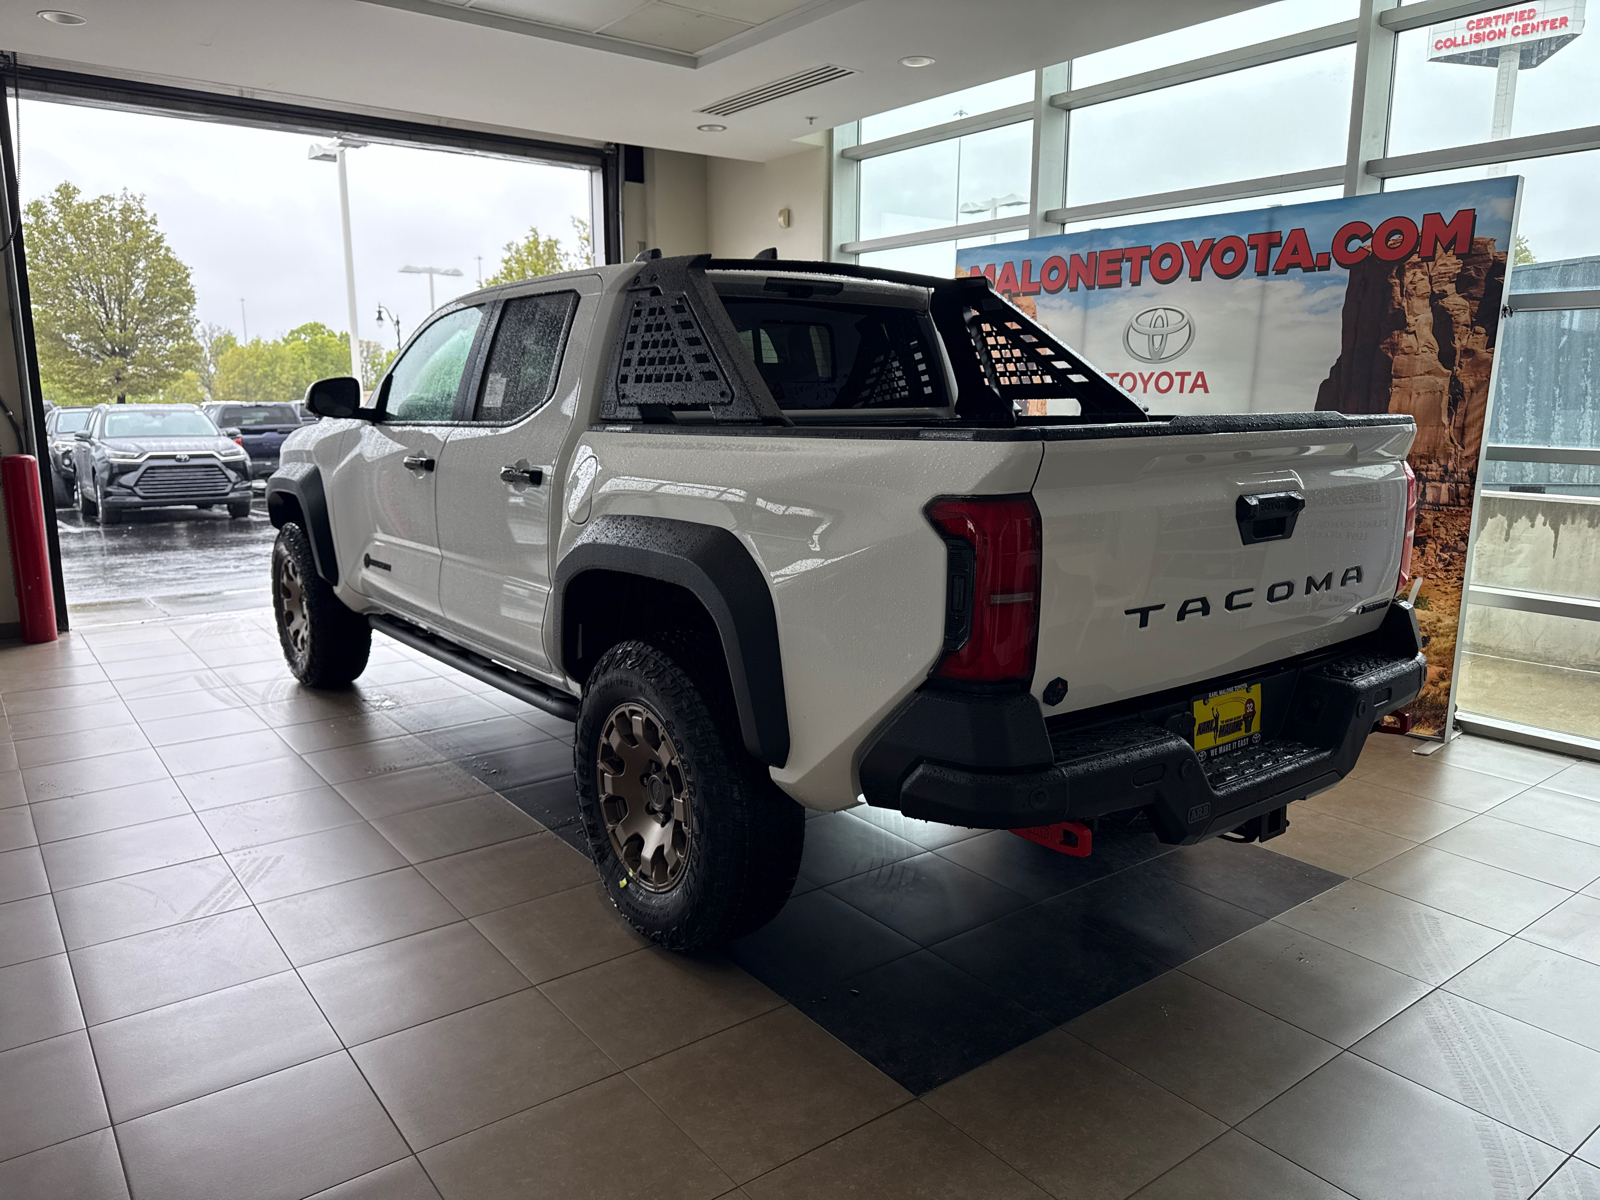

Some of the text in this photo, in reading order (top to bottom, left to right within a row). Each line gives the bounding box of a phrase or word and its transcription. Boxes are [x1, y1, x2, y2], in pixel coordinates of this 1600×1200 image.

[1466, 8, 1537, 31] CERTIFIED
[1434, 16, 1569, 51] COLLISION CENTER
[970, 208, 1476, 299] MALONETOYOTA.COM
[1124, 564, 1364, 629] TACOMA
[1246, 703, 1253, 713] 32
[1210, 737, 1249, 757] WE MAKE IT EASY
[1190, 805, 1209, 820] ARB
